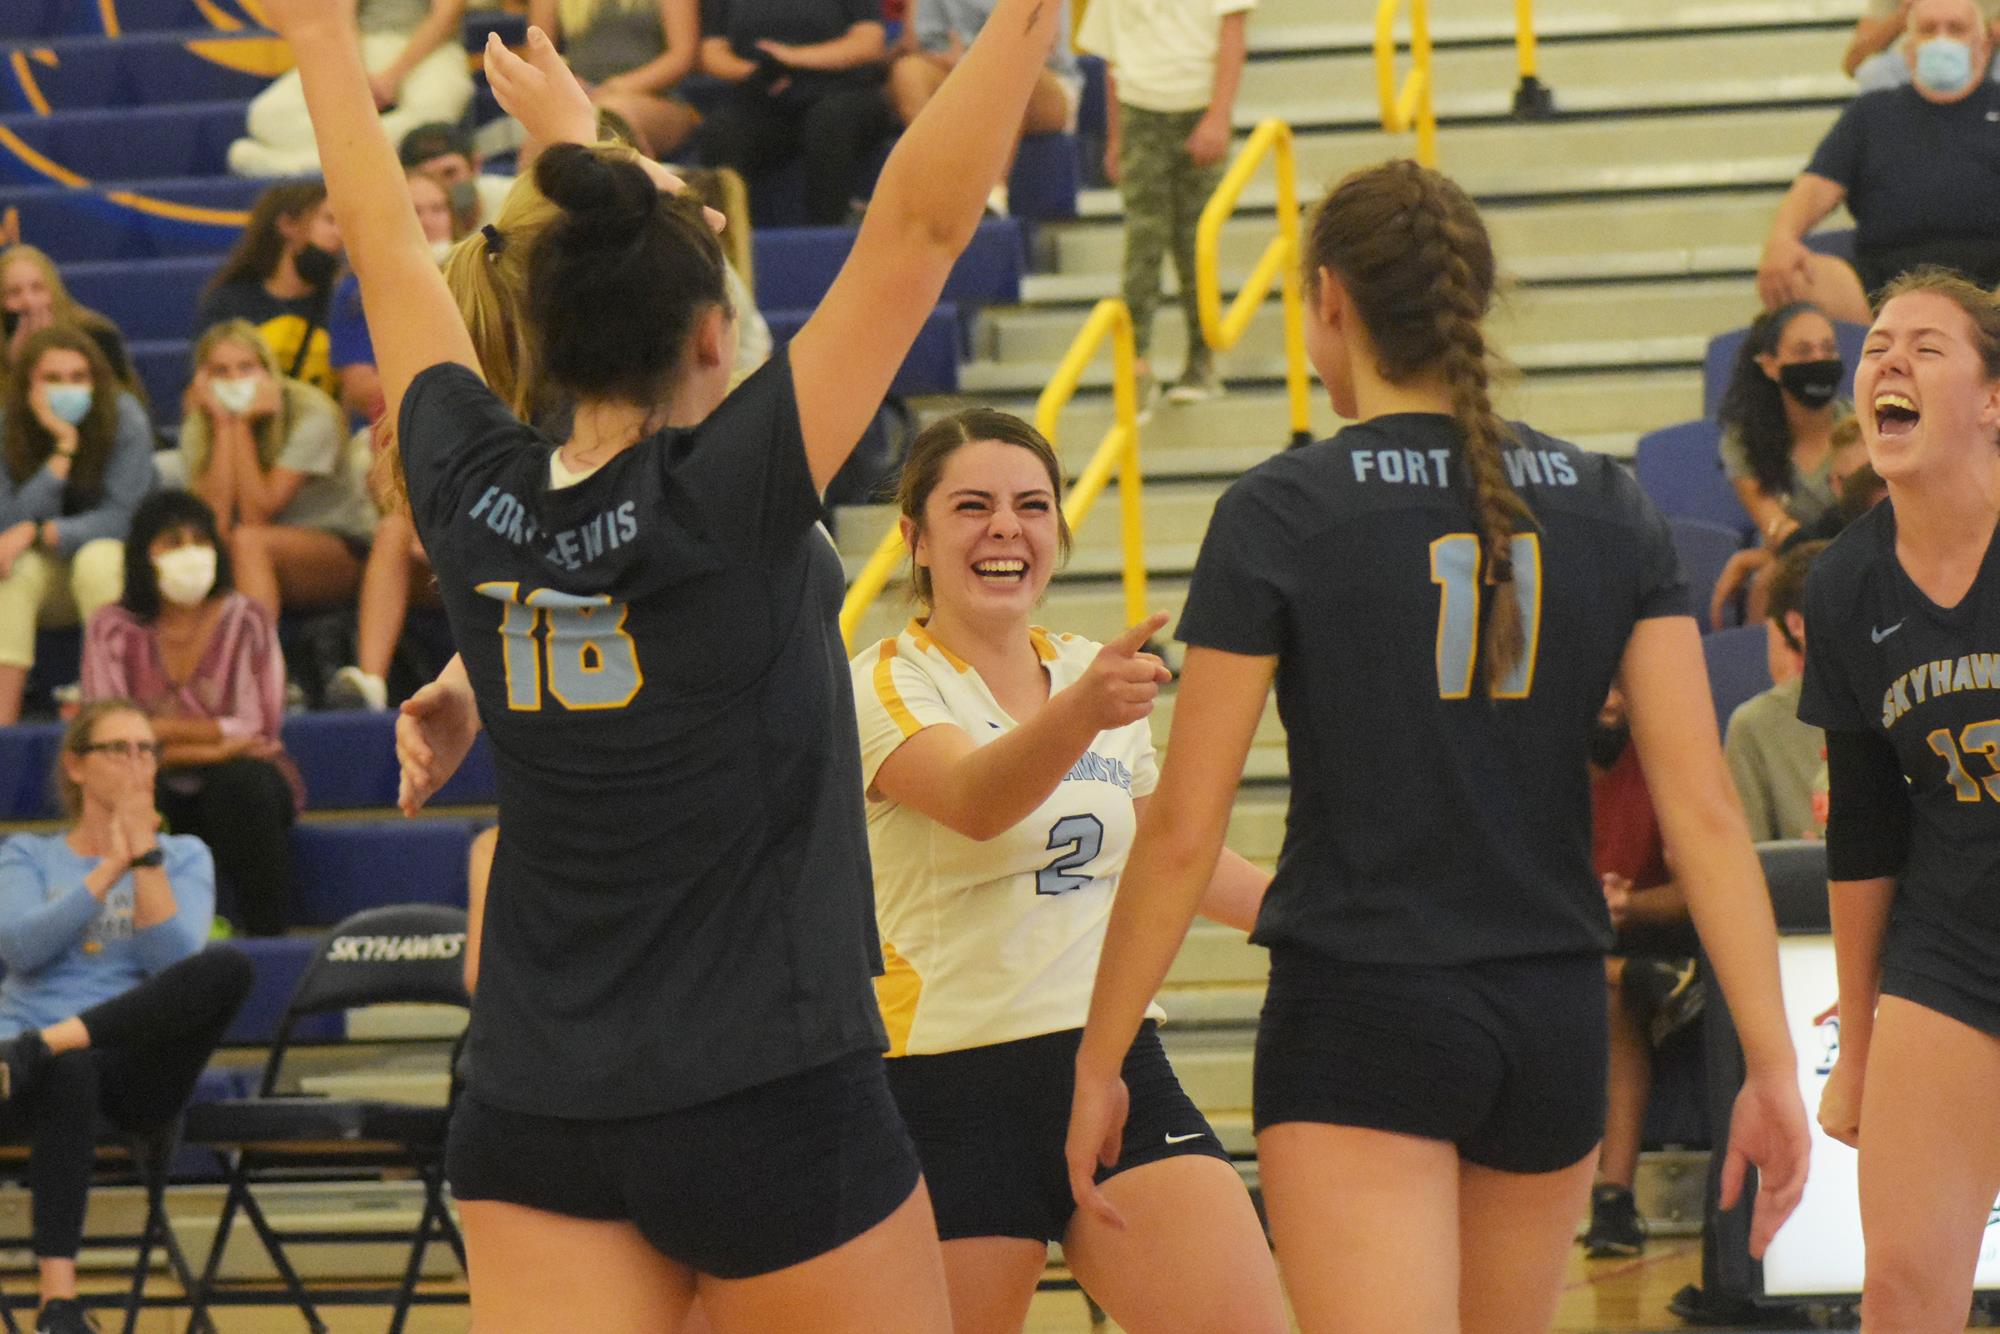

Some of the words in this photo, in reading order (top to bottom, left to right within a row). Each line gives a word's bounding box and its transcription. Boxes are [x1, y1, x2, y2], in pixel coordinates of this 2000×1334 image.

[1351, 448, 1450, 488] FORT
[1502, 447, 1579, 487] WIS
[474, 581, 644, 711] 18
[1881, 653, 2000, 729] SKYHAW
[1035, 813, 1104, 895] 2
